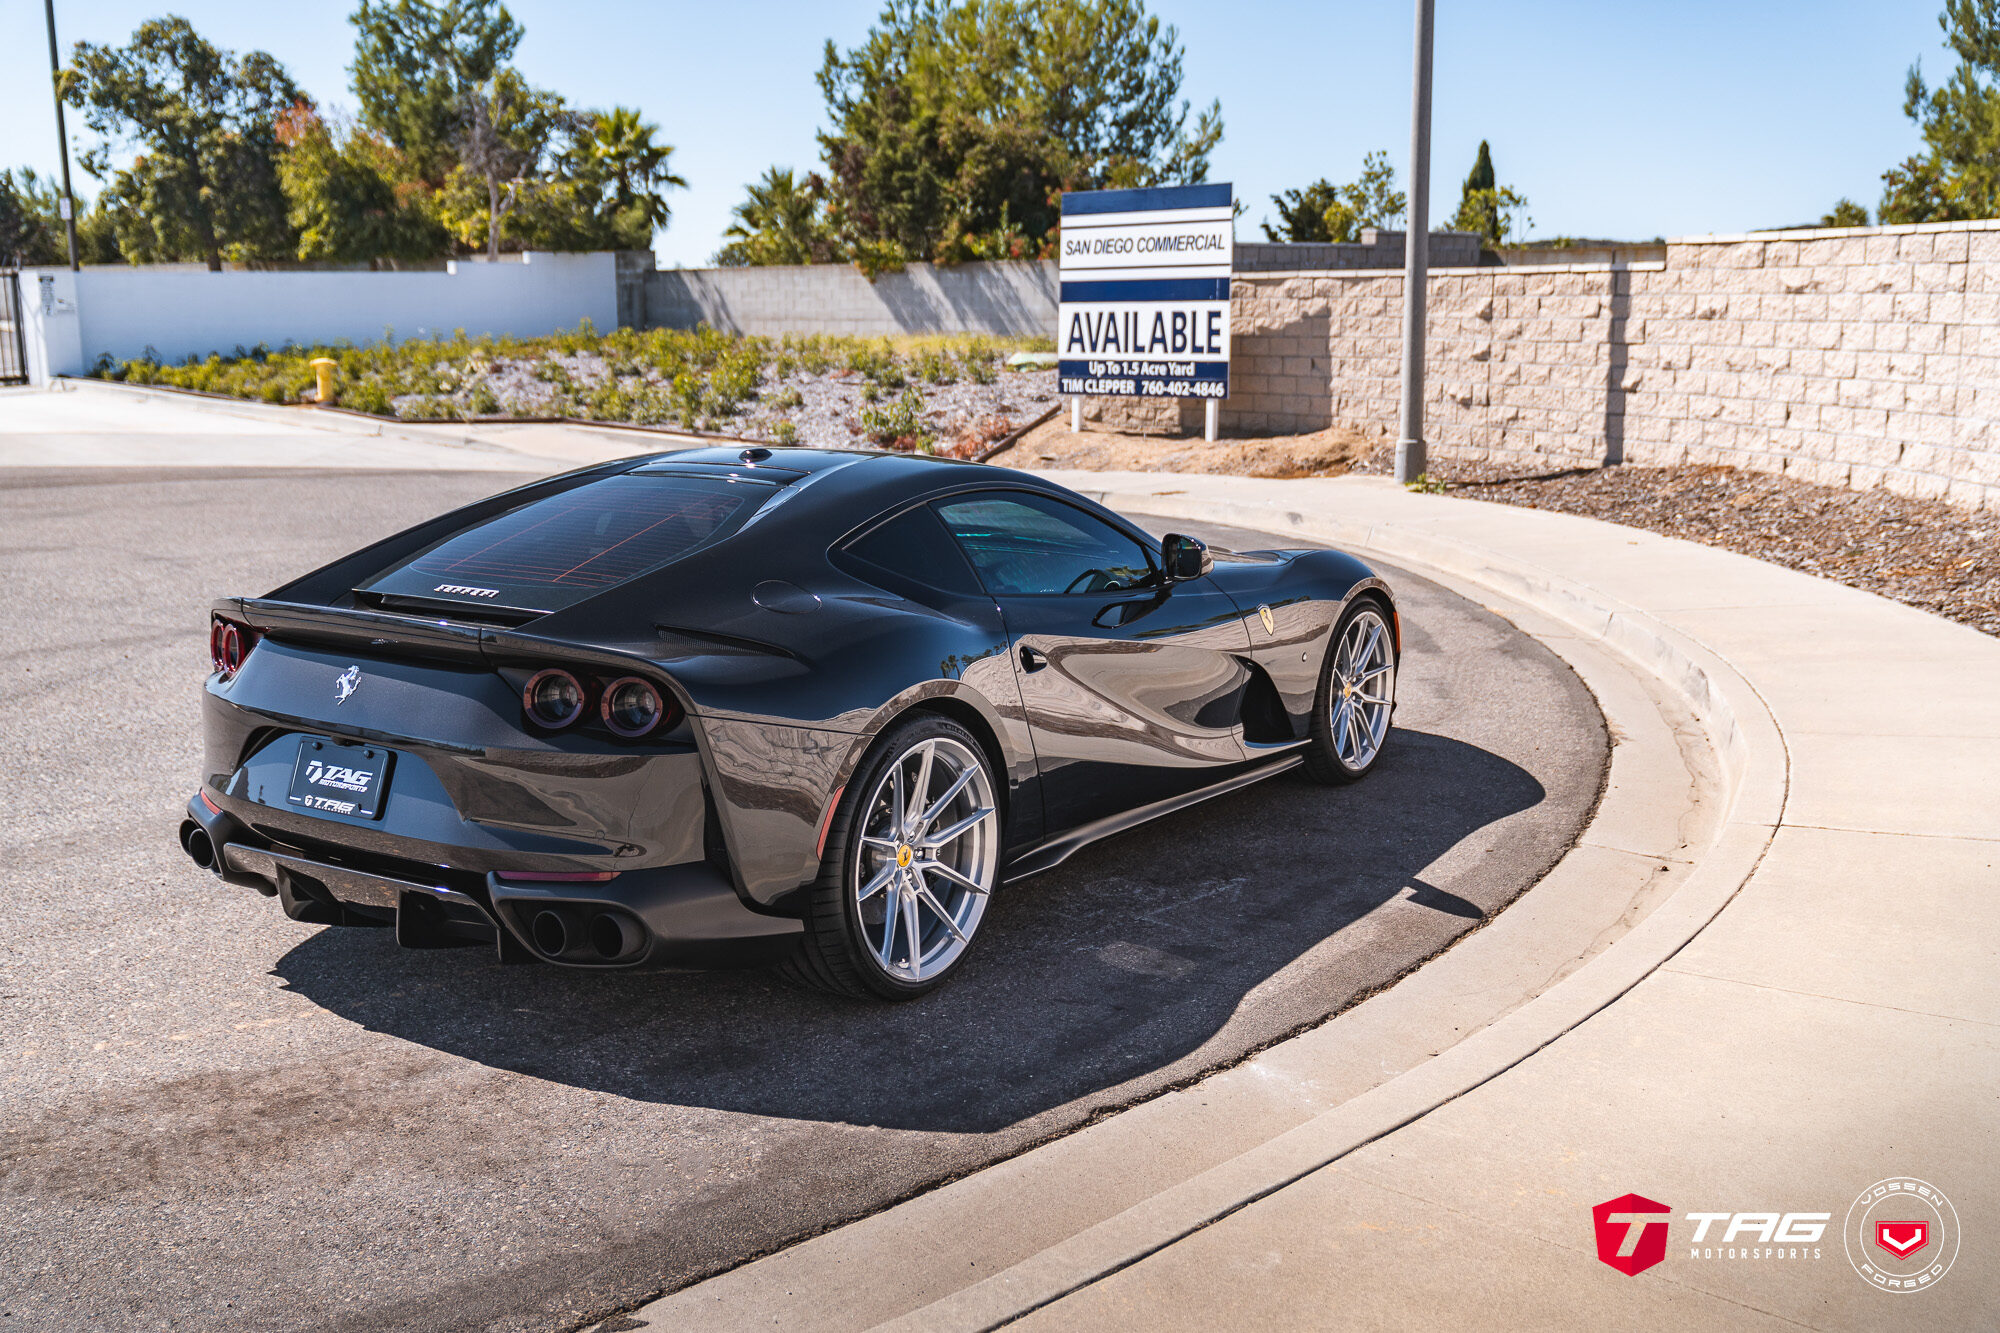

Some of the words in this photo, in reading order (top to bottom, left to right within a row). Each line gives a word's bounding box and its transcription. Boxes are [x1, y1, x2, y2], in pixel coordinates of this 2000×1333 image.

[1065, 240, 1091, 256] SAN
[1094, 238, 1133, 254] DIEGO
[1137, 234, 1225, 253] COMMERCIAL
[1067, 311, 1222, 354] AVAILABLE
[1088, 361, 1105, 377] Up
[1105, 361, 1121, 375] To
[1122, 362, 1139, 376] 1.5
[1141, 362, 1167, 376] Acre
[1168, 362, 1195, 377] Yard
[1062, 378, 1083, 393] TIM
[1085, 379, 1136, 395] CLEPPER
[1141, 380, 1225, 398] 760-402-4846
[323, 765, 373, 785] TAG
